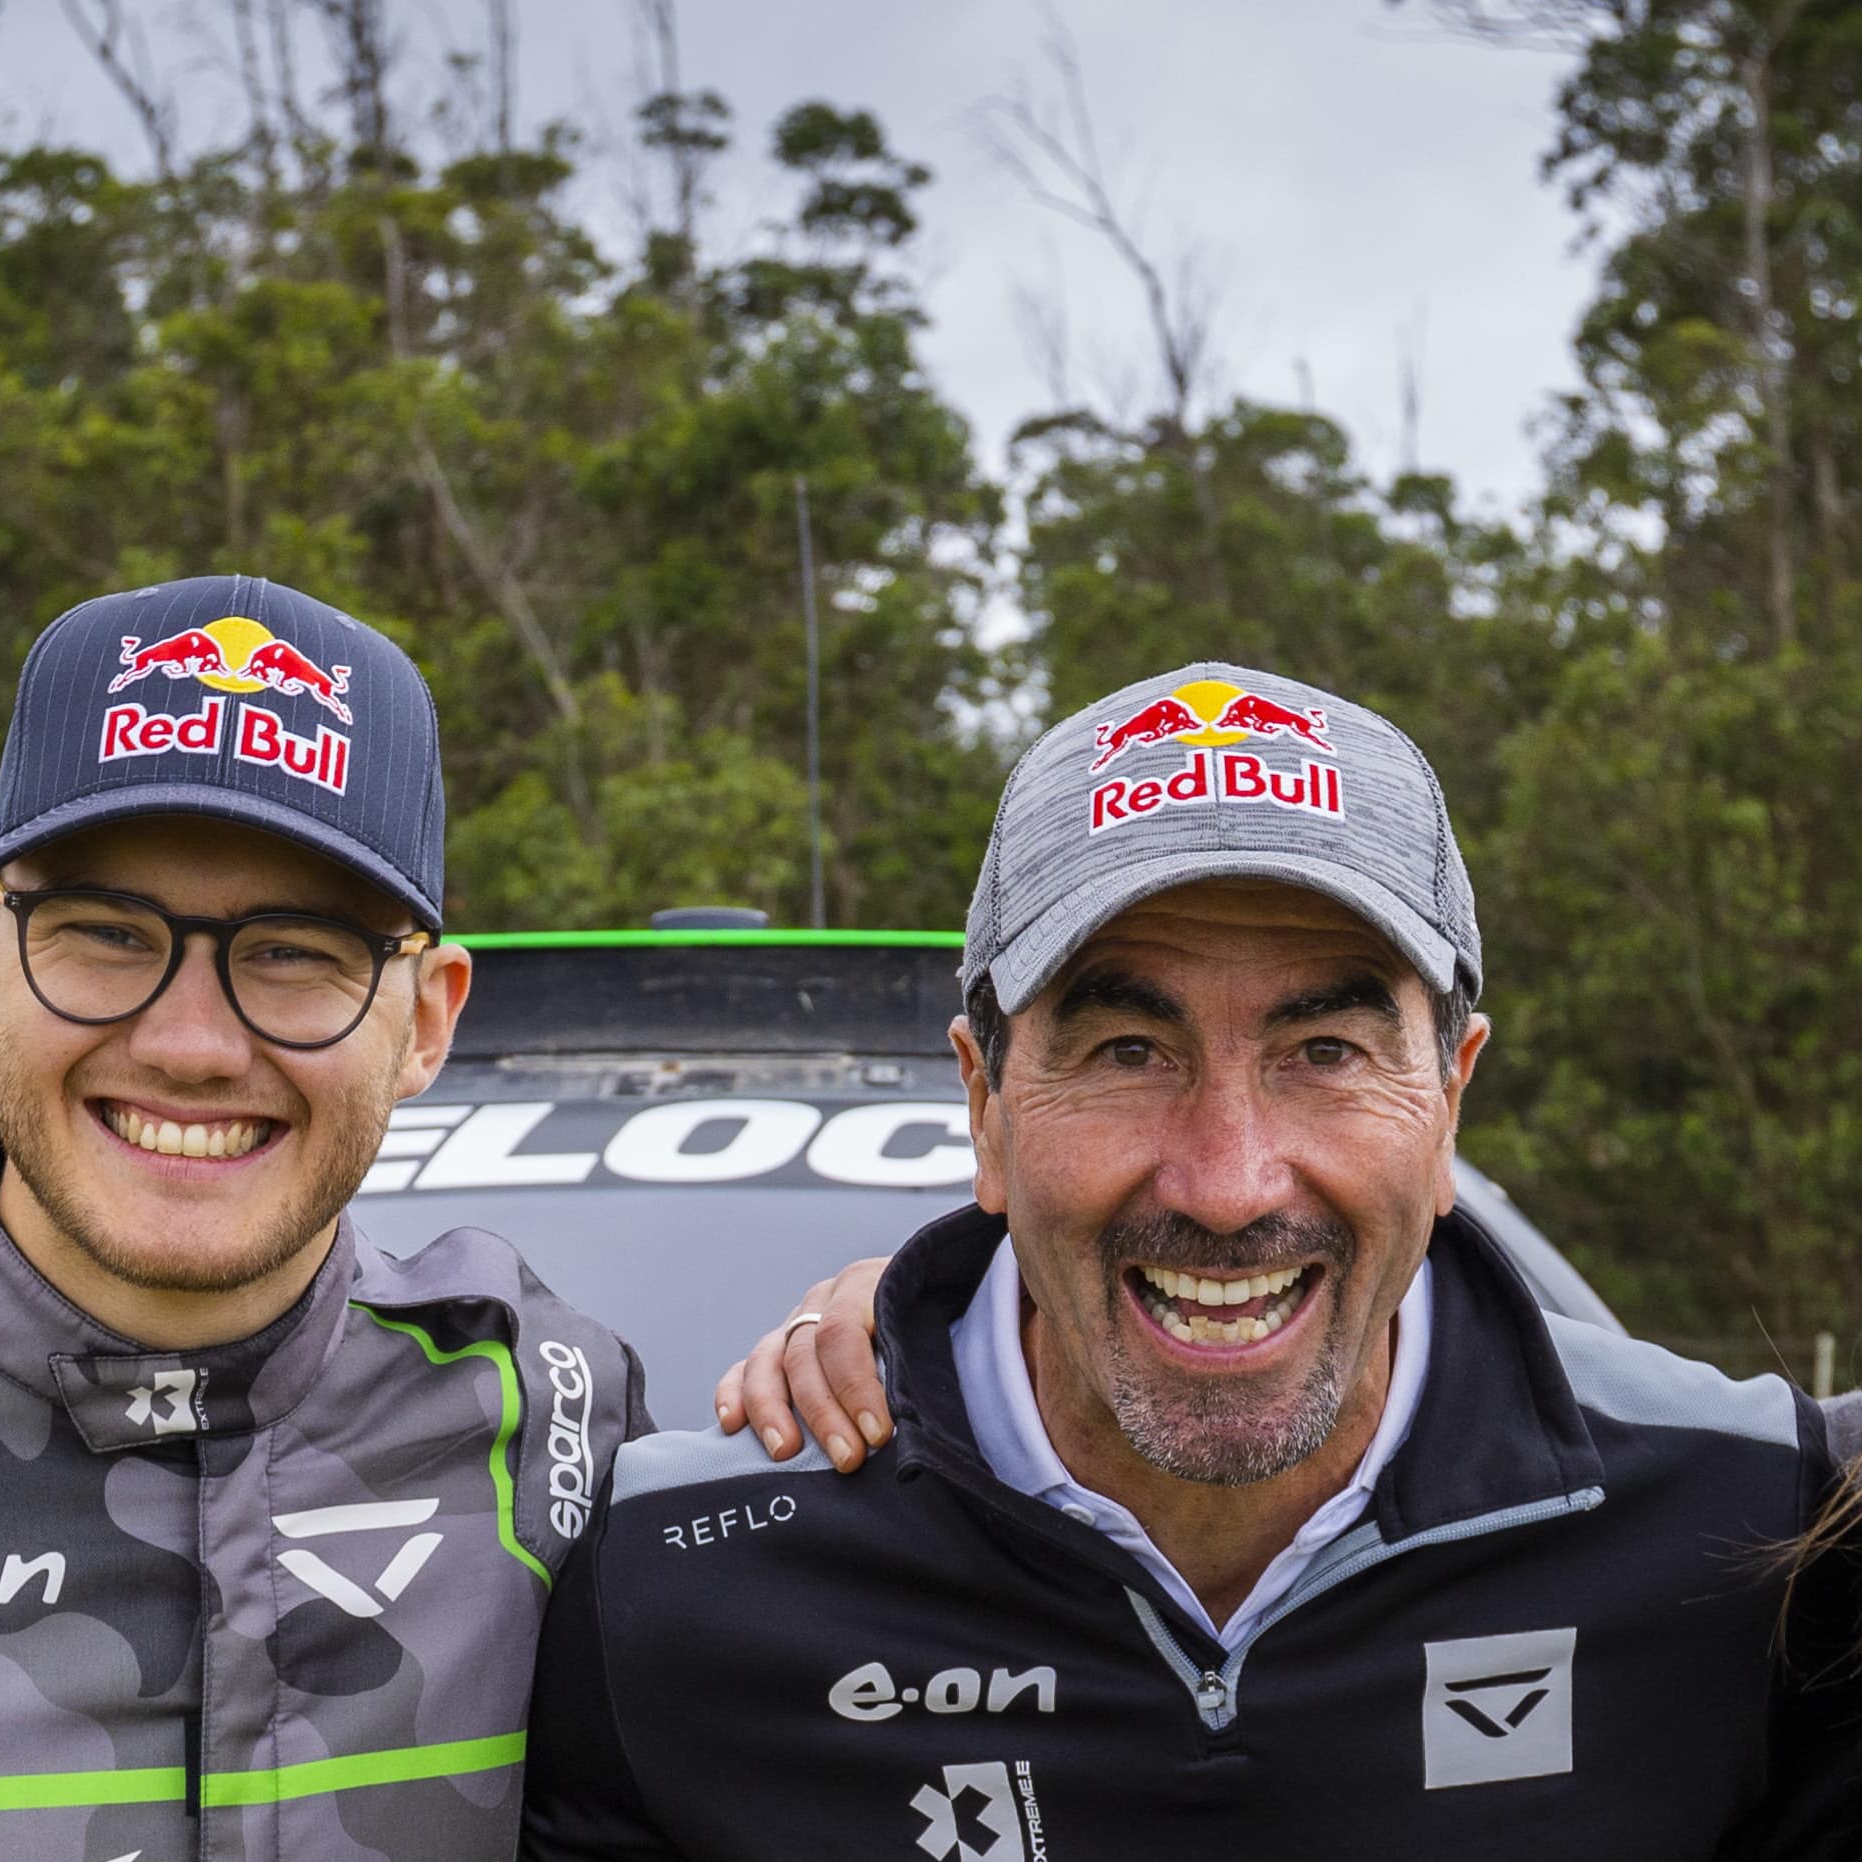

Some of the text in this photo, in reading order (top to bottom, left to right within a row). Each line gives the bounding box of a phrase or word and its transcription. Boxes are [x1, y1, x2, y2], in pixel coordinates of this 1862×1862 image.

[98, 697, 351, 796] Red Bull
[1089, 748, 1345, 836] Red Bull
[538, 1340, 593, 1539] sparco
[662, 1495, 797, 1550] REFLO
